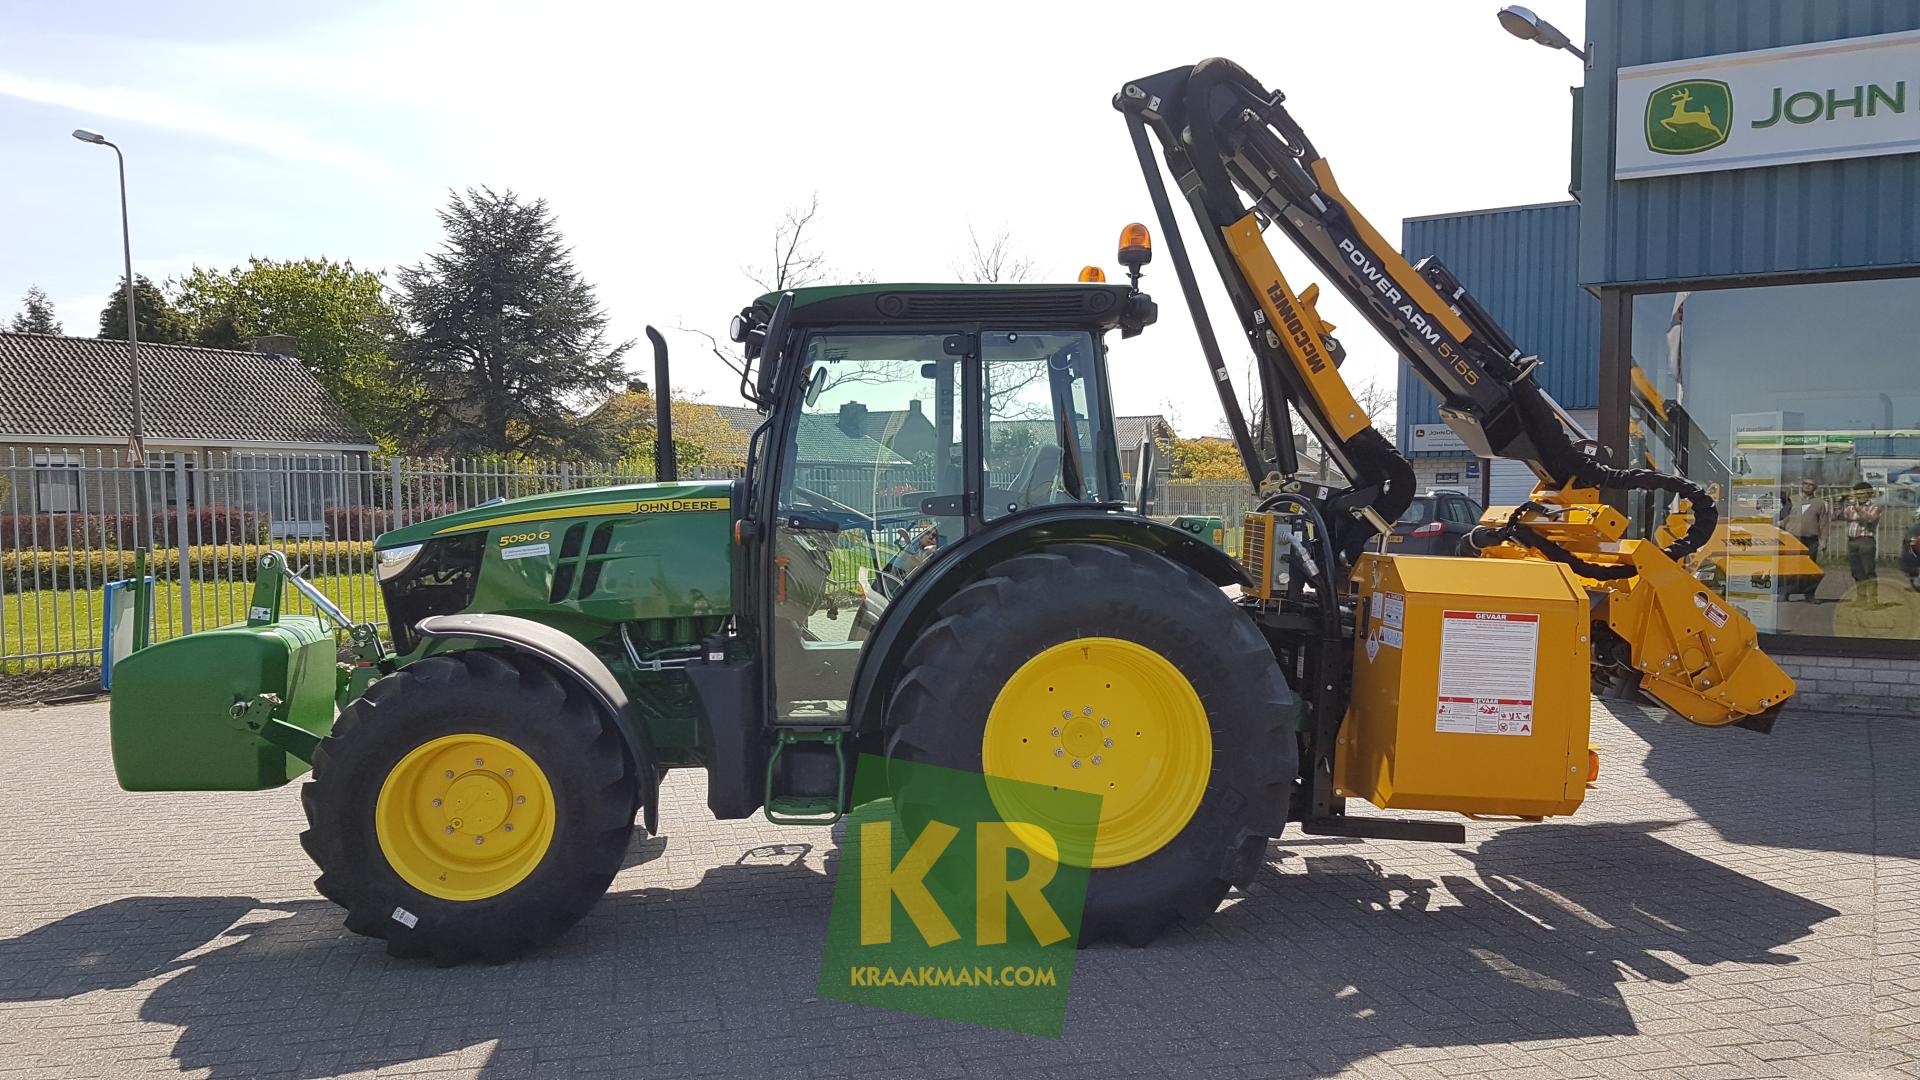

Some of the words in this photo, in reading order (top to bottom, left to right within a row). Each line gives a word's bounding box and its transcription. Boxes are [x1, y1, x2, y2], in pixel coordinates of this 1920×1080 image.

[1751, 81, 1905, 128] JOHN
[1339, 238, 1402, 305] POWER
[1398, 304, 1441, 345] ARM
[1437, 342, 1479, 385] 5155
[631, 502, 669, 513] JOHN
[671, 500, 719, 511] DEERE
[499, 532, 537, 546] 5090
[538, 531, 550, 540] G
